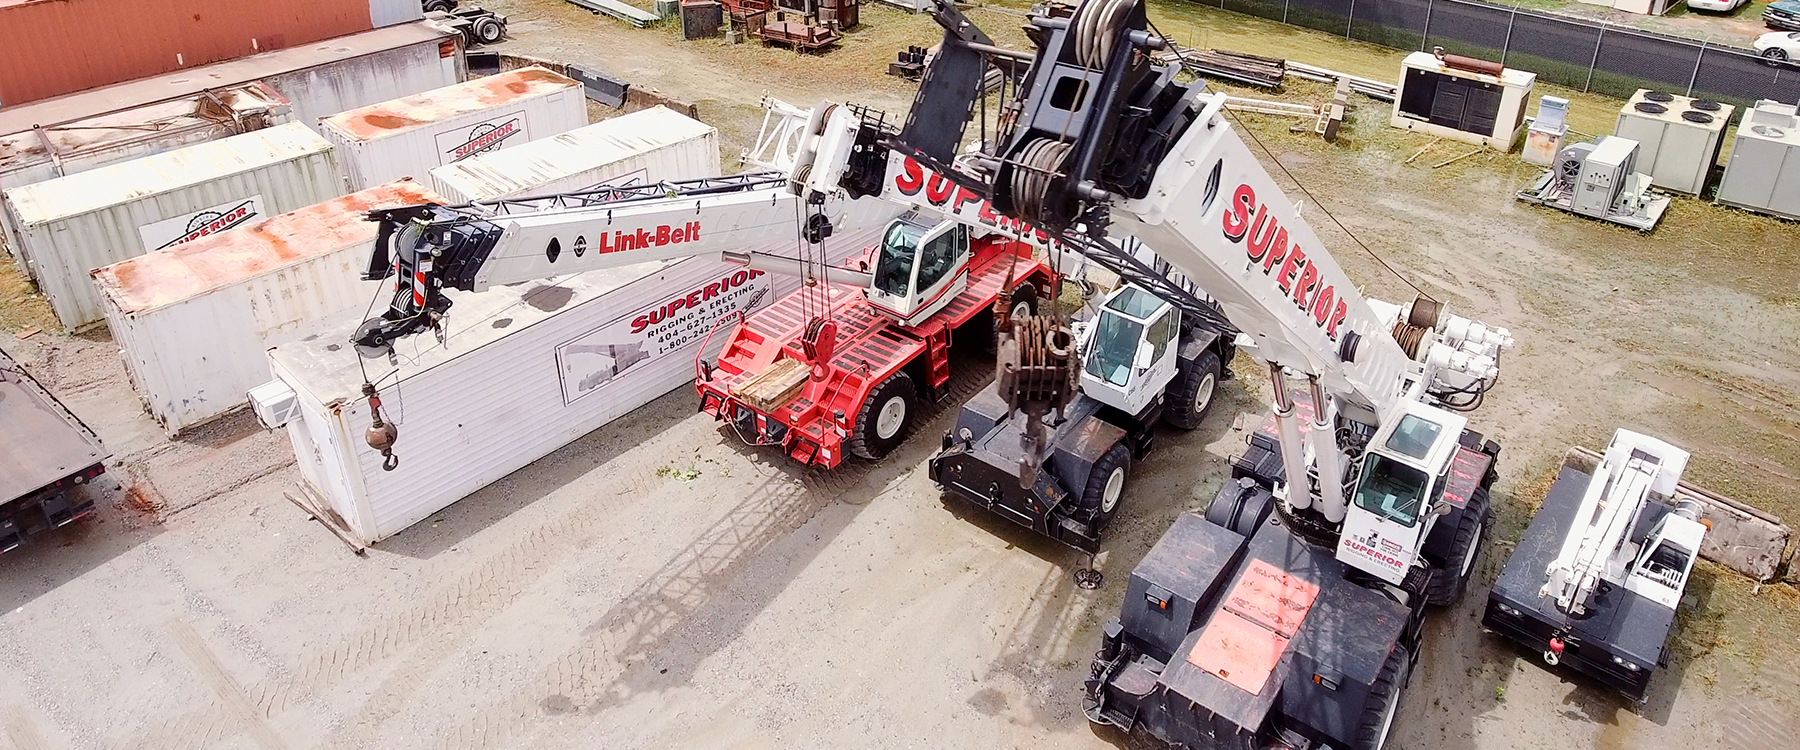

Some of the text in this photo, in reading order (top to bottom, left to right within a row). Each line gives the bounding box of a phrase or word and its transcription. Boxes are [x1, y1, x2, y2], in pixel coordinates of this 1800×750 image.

[455, 123, 513, 158] SUPERIOR
[169, 207, 248, 248] PERIOR
[599, 221, 701, 254] Link-Belt
[1222, 183, 1348, 342] SUPERIOR
[647, 312, 695, 339] RIGGING
[698, 305, 706, 315] &
[709, 283, 755, 310] ERECTING
[657, 301, 737, 344] 404-627-1335
[1343, 539, 1404, 569] SUPERIOR
[1346, 547, 1368, 559] RIGGING
[1373, 558, 1401, 573] ERECTING
